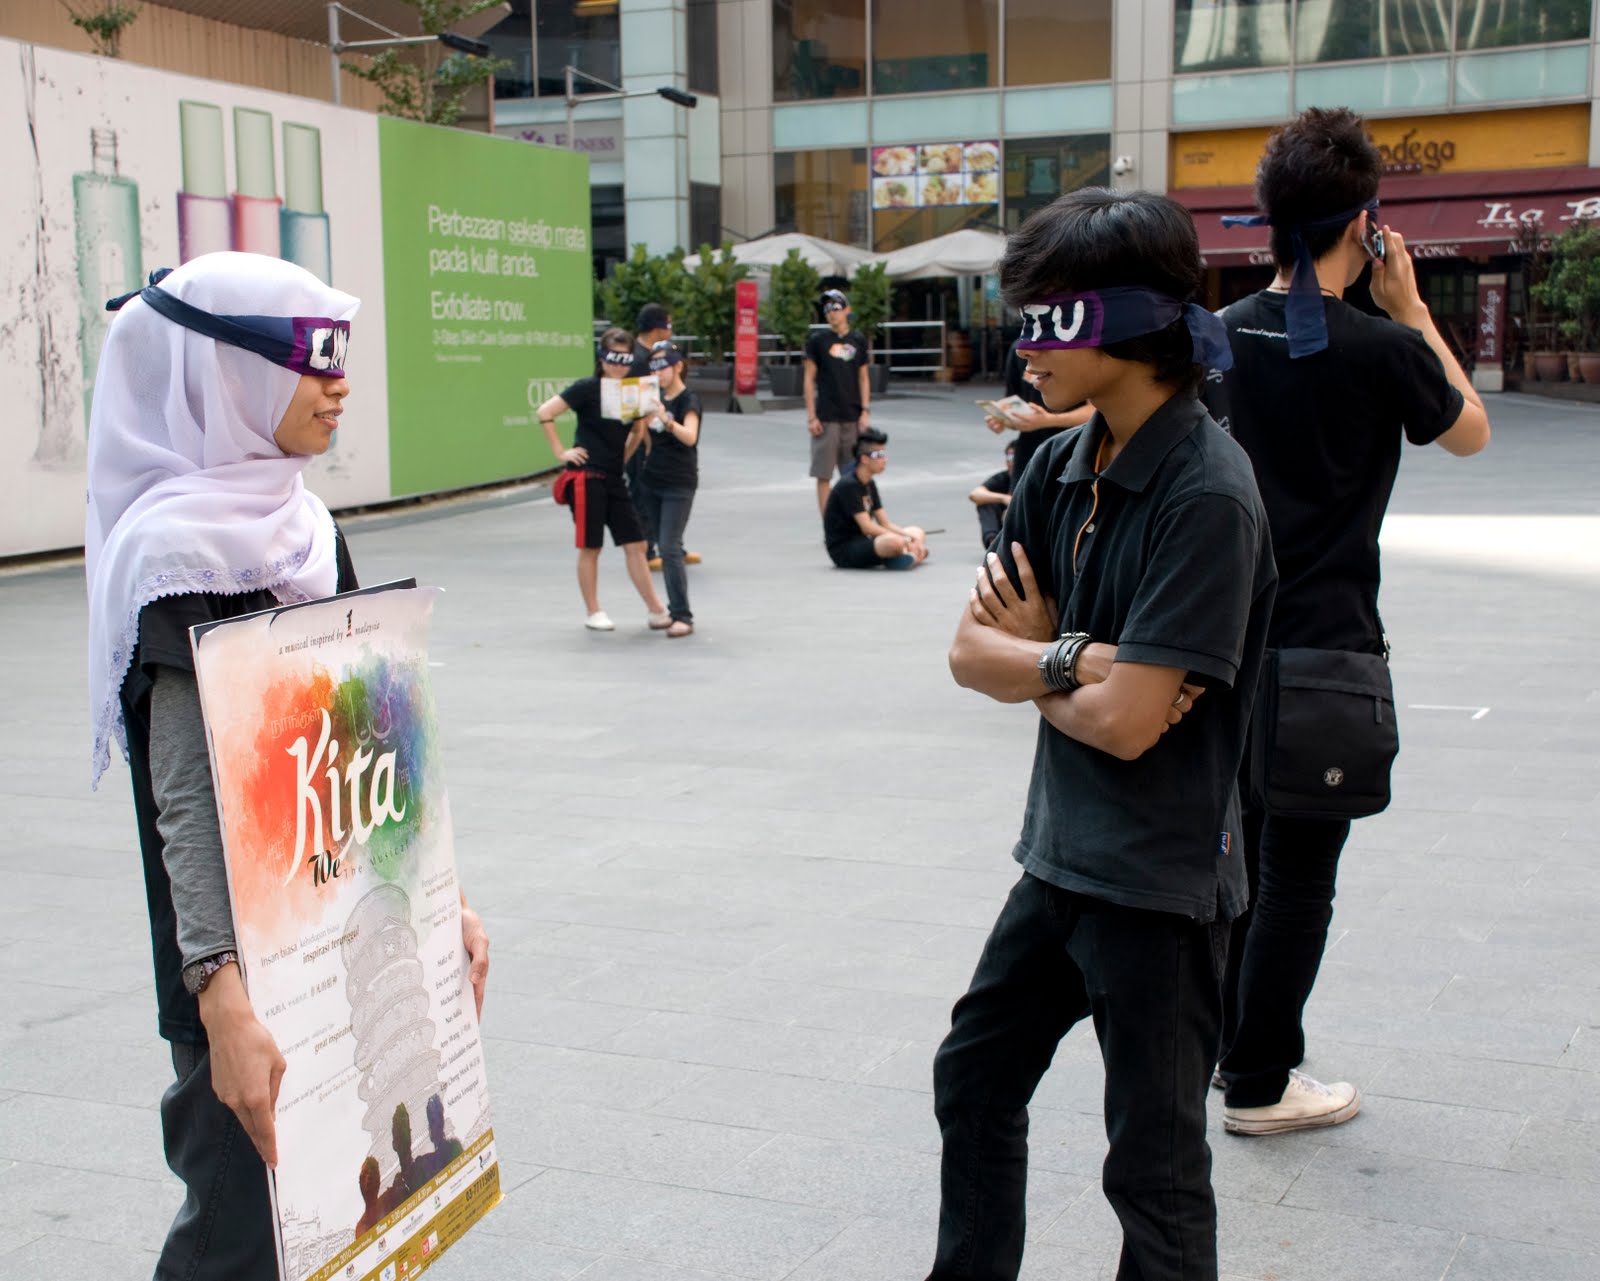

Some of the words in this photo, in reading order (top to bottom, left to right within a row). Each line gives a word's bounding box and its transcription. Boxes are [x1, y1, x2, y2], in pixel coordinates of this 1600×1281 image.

[1378, 127, 1456, 172] odega
[428, 204, 506, 241] Perbezaan
[555, 226, 587, 249] mata
[429, 244, 469, 278] pada
[470, 245, 499, 275] kulit
[431, 290, 491, 321] Exfoliate
[1019, 300, 1085, 342] TU
[285, 636, 309, 653] musical
[310, 628, 335, 648] inspired
[336, 628, 344, 643] by
[346, 609, 353, 637] 1
[285, 706, 406, 887] Kita
[307, 850, 342, 888] We
[261, 952, 280, 968] Insan
[280, 943, 298, 958] biasa
[303, 940, 330, 965] inspirasi
[331, 924, 360, 950] terunggul
